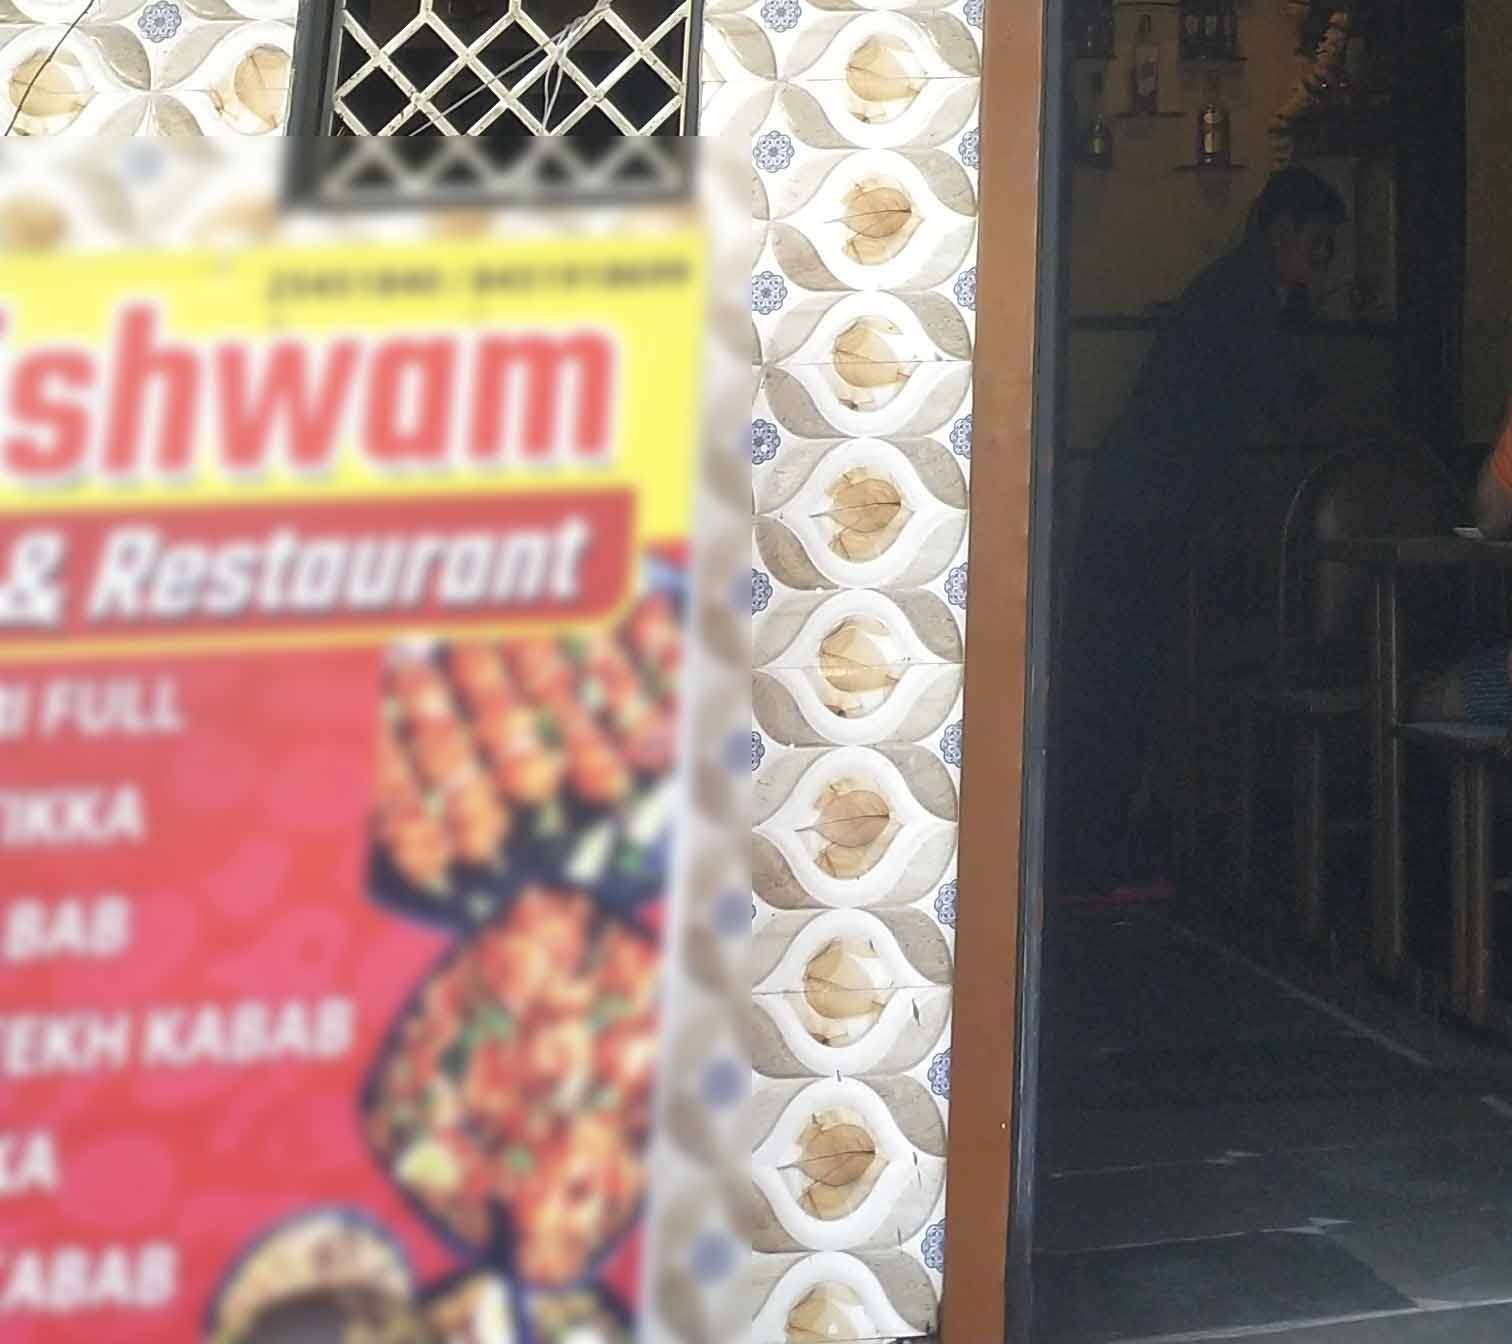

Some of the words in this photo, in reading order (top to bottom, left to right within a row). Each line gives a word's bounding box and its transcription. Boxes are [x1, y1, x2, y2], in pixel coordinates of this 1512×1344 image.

[0, 304, 614, 478] shwam
[0, 530, 66, 626] &
[88, 516, 592, 618] Restaurant
[42, 669, 188, 738] FULL
[145, 997, 354, 1066] KABAB
[0, 1246, 178, 1312] ABAB
